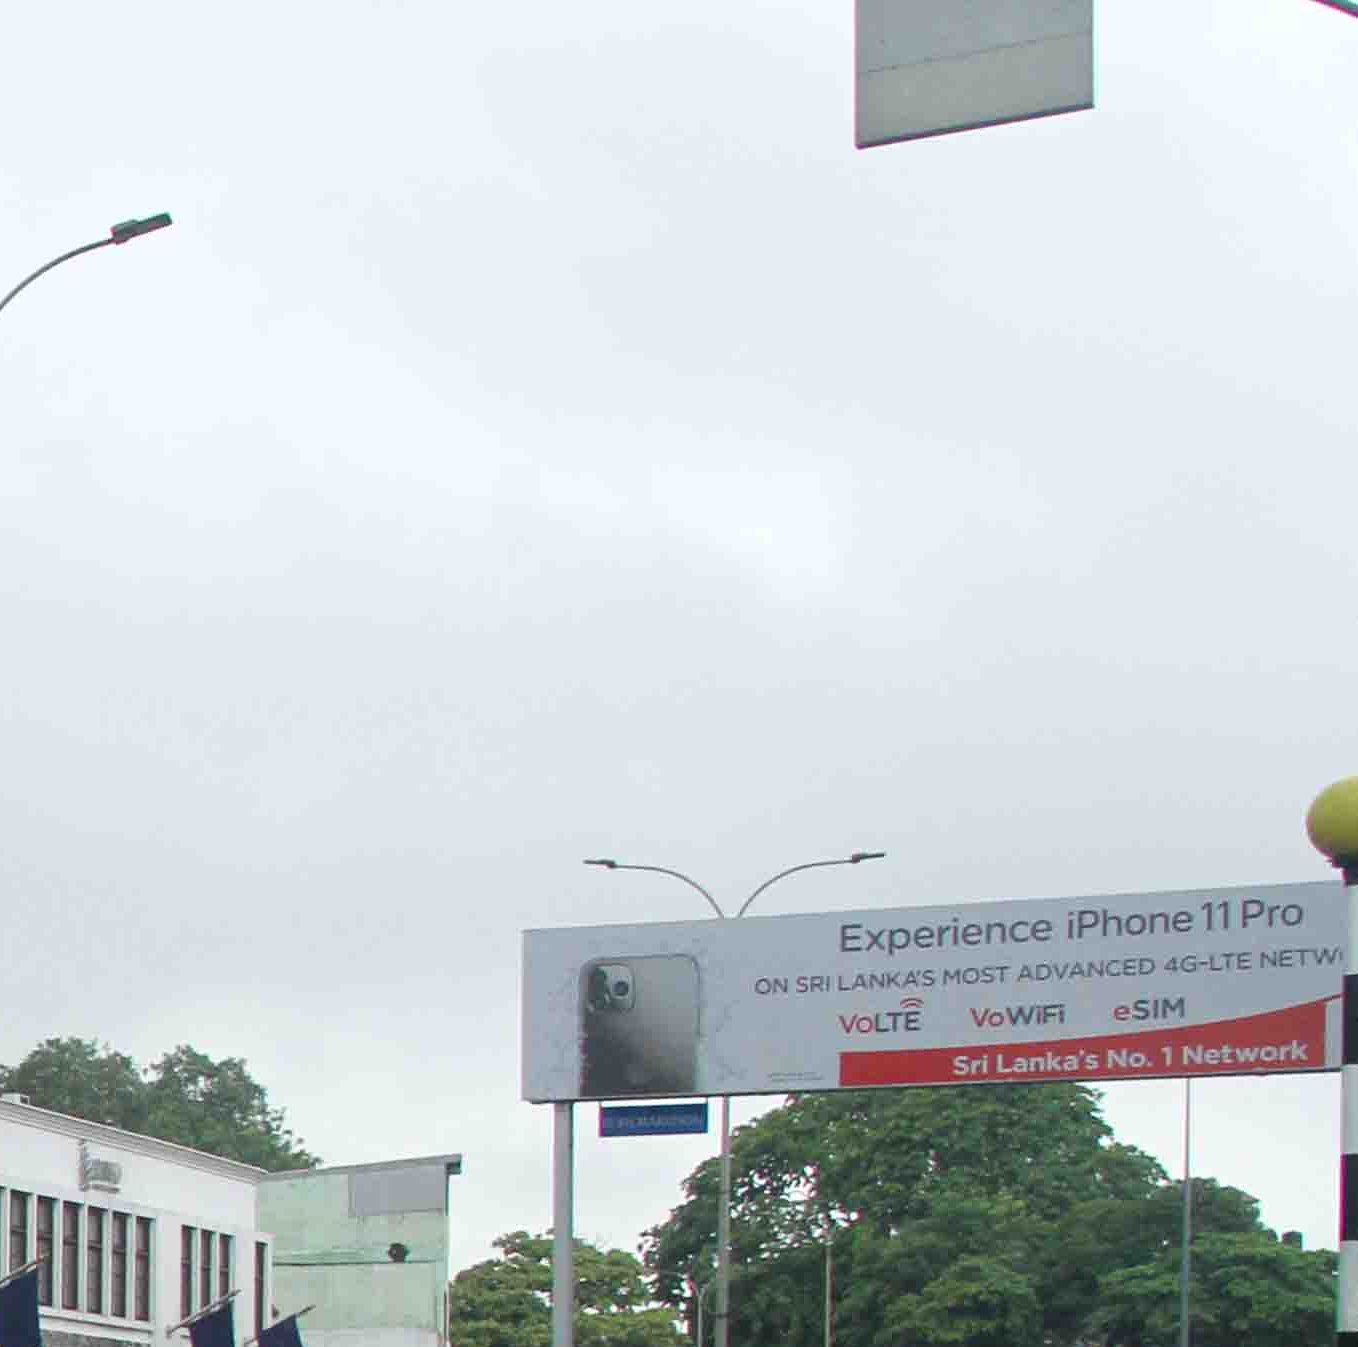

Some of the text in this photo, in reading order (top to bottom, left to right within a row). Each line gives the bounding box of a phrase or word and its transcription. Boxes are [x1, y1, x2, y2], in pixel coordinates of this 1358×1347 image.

[840, 898, 1304, 956] Experience iPhone 11 Pro
[754, 948, 1344, 995] ON SRI LANKA'S MOST ADVANCED 4G-LTE NETW
[969, 1003, 1065, 1029] VoWiFi
[1113, 997, 1185, 1022] eSIM
[952, 1039, 1309, 1076] Sri Lanka's No. 1 Network
